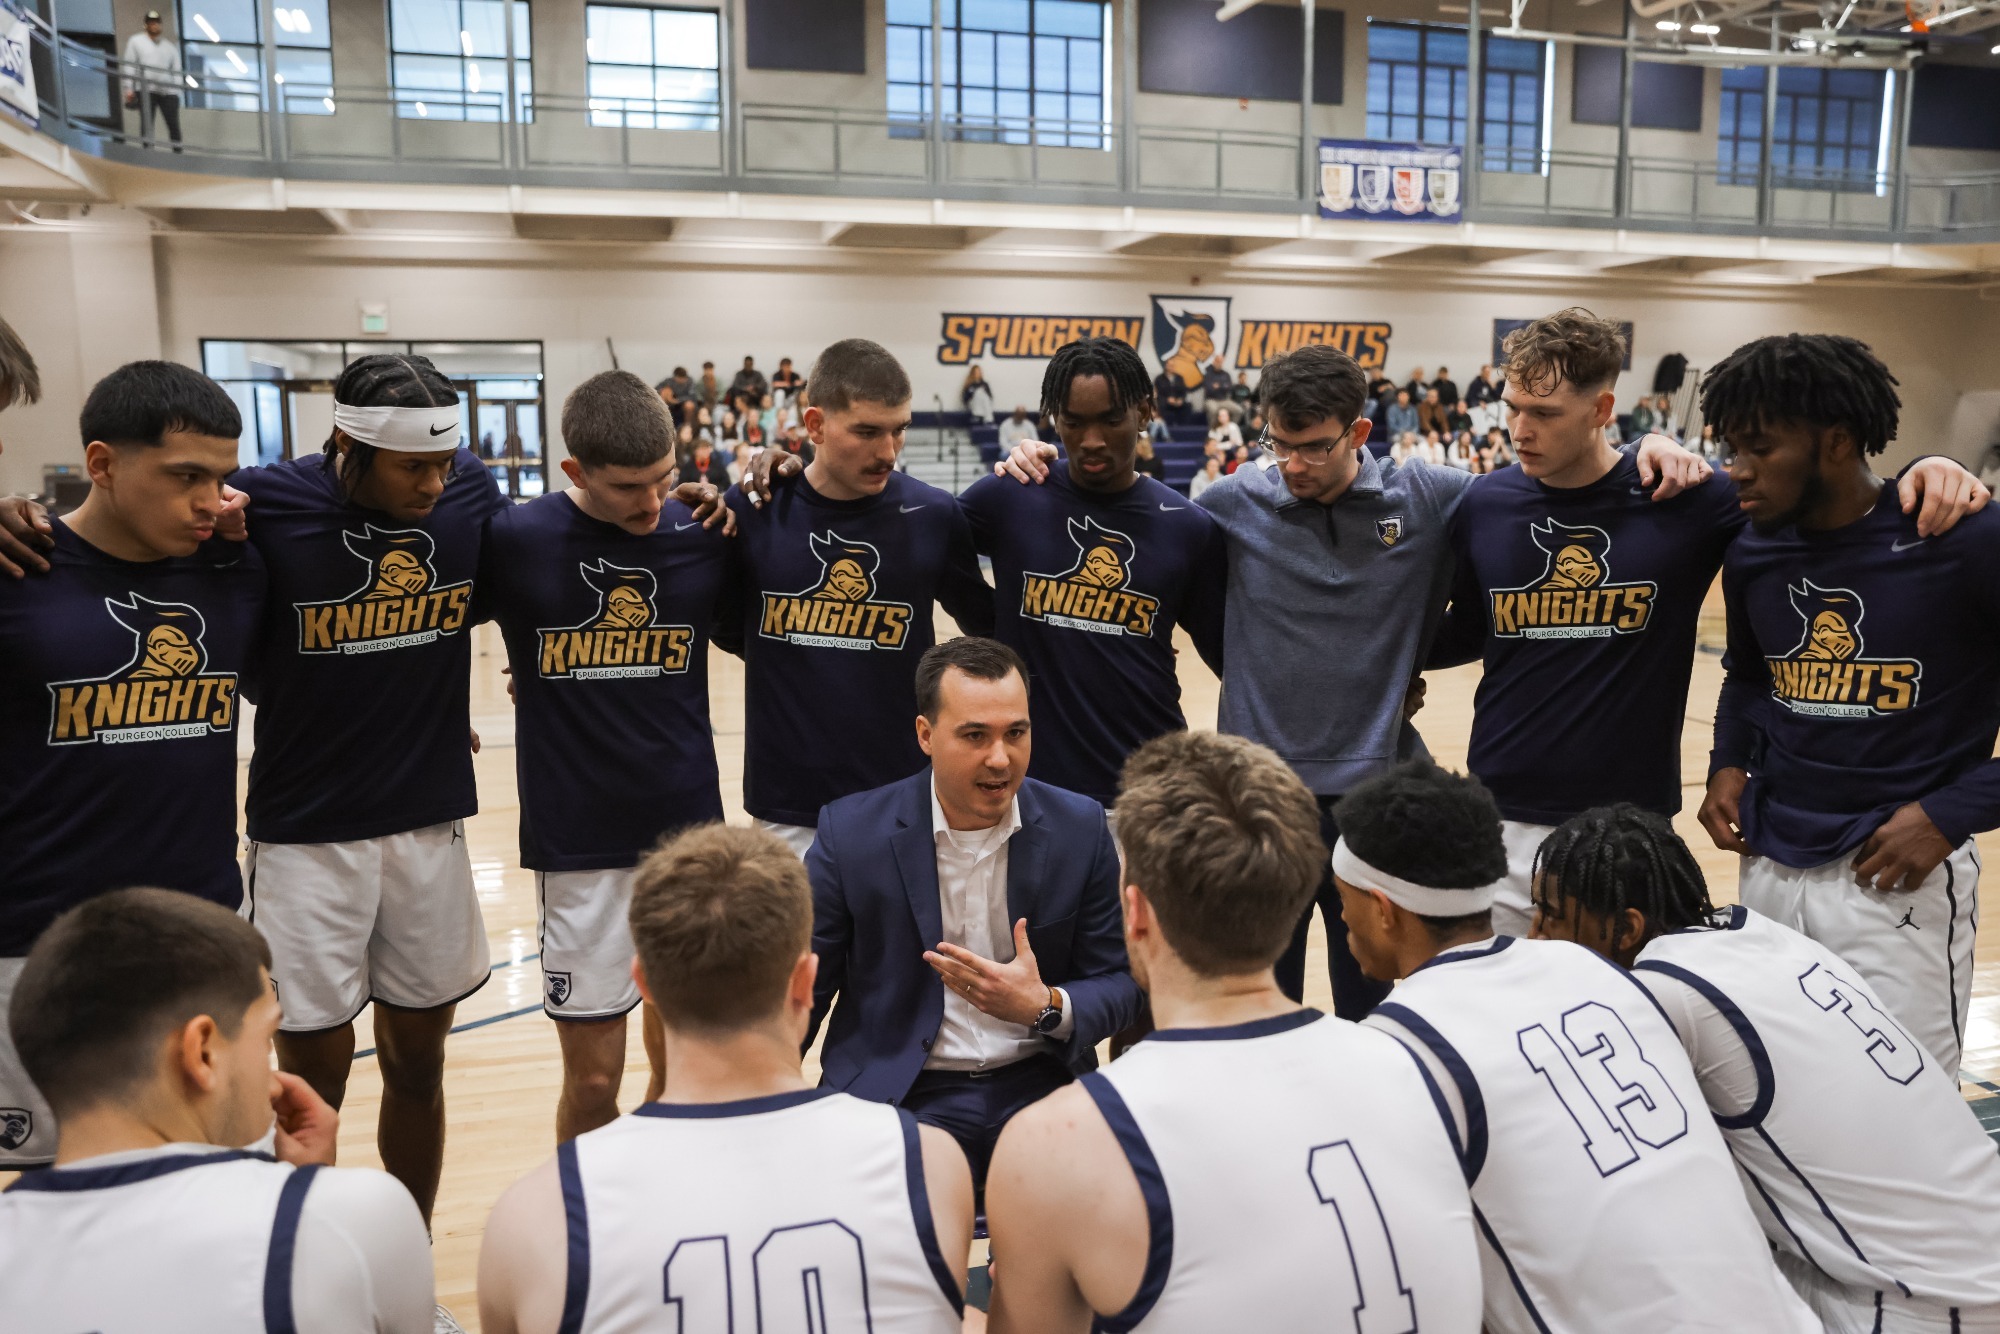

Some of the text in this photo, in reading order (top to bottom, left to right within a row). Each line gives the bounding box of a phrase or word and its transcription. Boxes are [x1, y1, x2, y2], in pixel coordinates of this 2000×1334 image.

[304, 585, 471, 648] KNIGHTS
[763, 597, 909, 645] KNIGHTS
[1024, 577, 1156, 634] KNIGHTS
[1049, 617, 1121, 634] SPURGEON COLLEGE
[1494, 586, 1651, 632] KNIGHTS
[346, 633, 436, 653] SPURGEON COLLEGE
[541, 629, 690, 673] KNIGHTS
[792, 636, 870, 649] SPURGEON COLLEGE
[1527, 628, 1610, 638] SPURGEON COLLEGE
[577, 668, 659, 678] SPURGEON COLLEGE
[56, 678, 236, 738] KNIGHTS
[1828, 706, 1867, 716] COLLEGE
[105, 726, 206, 742] SPURGEON COLLEGE
[1798, 962, 1924, 1086] 3
[1517, 1001, 1687, 1178] 13
[1307, 1139, 1418, 1334] 1
